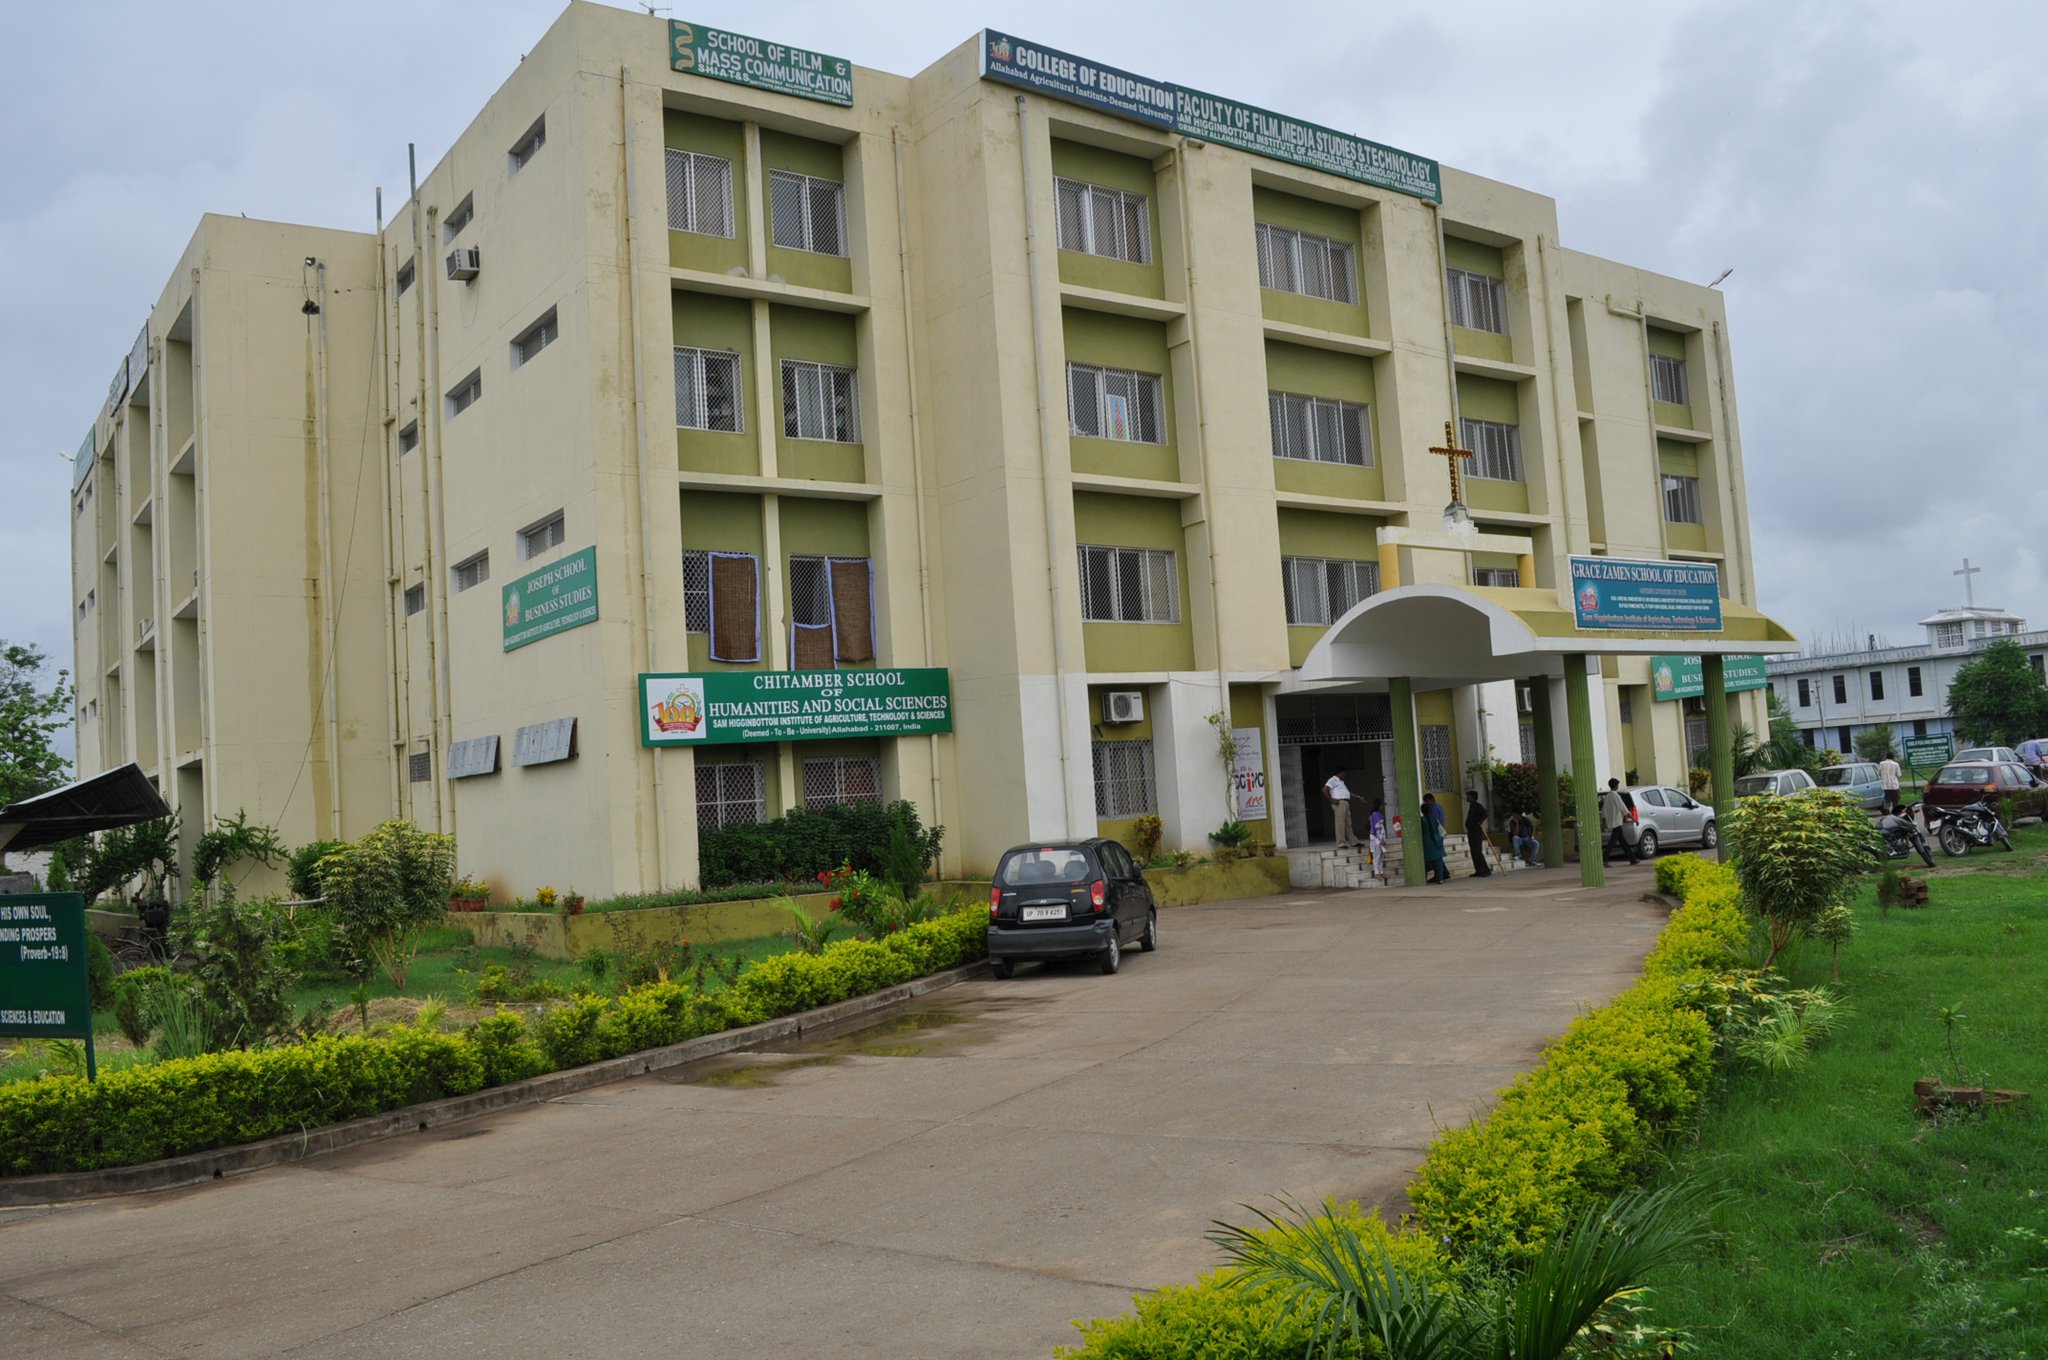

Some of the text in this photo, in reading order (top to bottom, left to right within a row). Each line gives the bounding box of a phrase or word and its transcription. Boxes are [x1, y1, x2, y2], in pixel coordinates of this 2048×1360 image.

[707, 31, 846, 76] SCHOOL OF FILM &
[697, 47, 852, 96] MASS COMMUNICATION
[1016, 46, 1174, 111] COLLEGE OF EDUCATION
[990, 61, 1028, 79] Allahabad
[1030, 73, 1074, 95] Agricultural
[1138, 104, 1174, 124] University
[1177, 91, 1233, 126] FACULTY
[1235, 107, 1250, 130] OF
[1281, 120, 1316, 148] MEDIA
[1316, 131, 1357, 161] STUDIES
[1364, 144, 1430, 182] TECHNOLOGY
[1193, 117, 1255, 140] HIGGINBOTTOM
[1256, 134, 1295, 152] INSTITUTE
[1296, 146, 1306, 156] OF
[527, 558, 587, 594] JOSEPH SCHOOL
[1572, 563, 1715, 584] GRACE ZAMEN SCHOOL OF EDUCATION
[552, 585, 560, 595] OF
[525, 585, 592, 622] BUSINESS STUDIES
[753, 671, 905, 690] CHITAMBER SCHOOL
[1723, 667, 1758, 679] STUDIES
[820, 688, 843, 697] OF
[709, 695, 947, 717] HUMANITIES AND SOCIAL SCIENCES
[713, 711, 945, 728] SAM HIGGINBOTTOM INSTITUTE OF AGRICULTURE, TECHNOLOGY & SCIENCES
[743, 728, 769, 739] (Deemed
[774, 728, 782, 736] To
[787, 727, 795, 735] Be
[832, 725, 868, 733] Allahabad
[1, 905, 51, 922] HIS OWN SOUL,
[22, 927, 57, 941] PROSPERS
[1, 1010, 65, 1024] SCIENCES & EDUCATION
